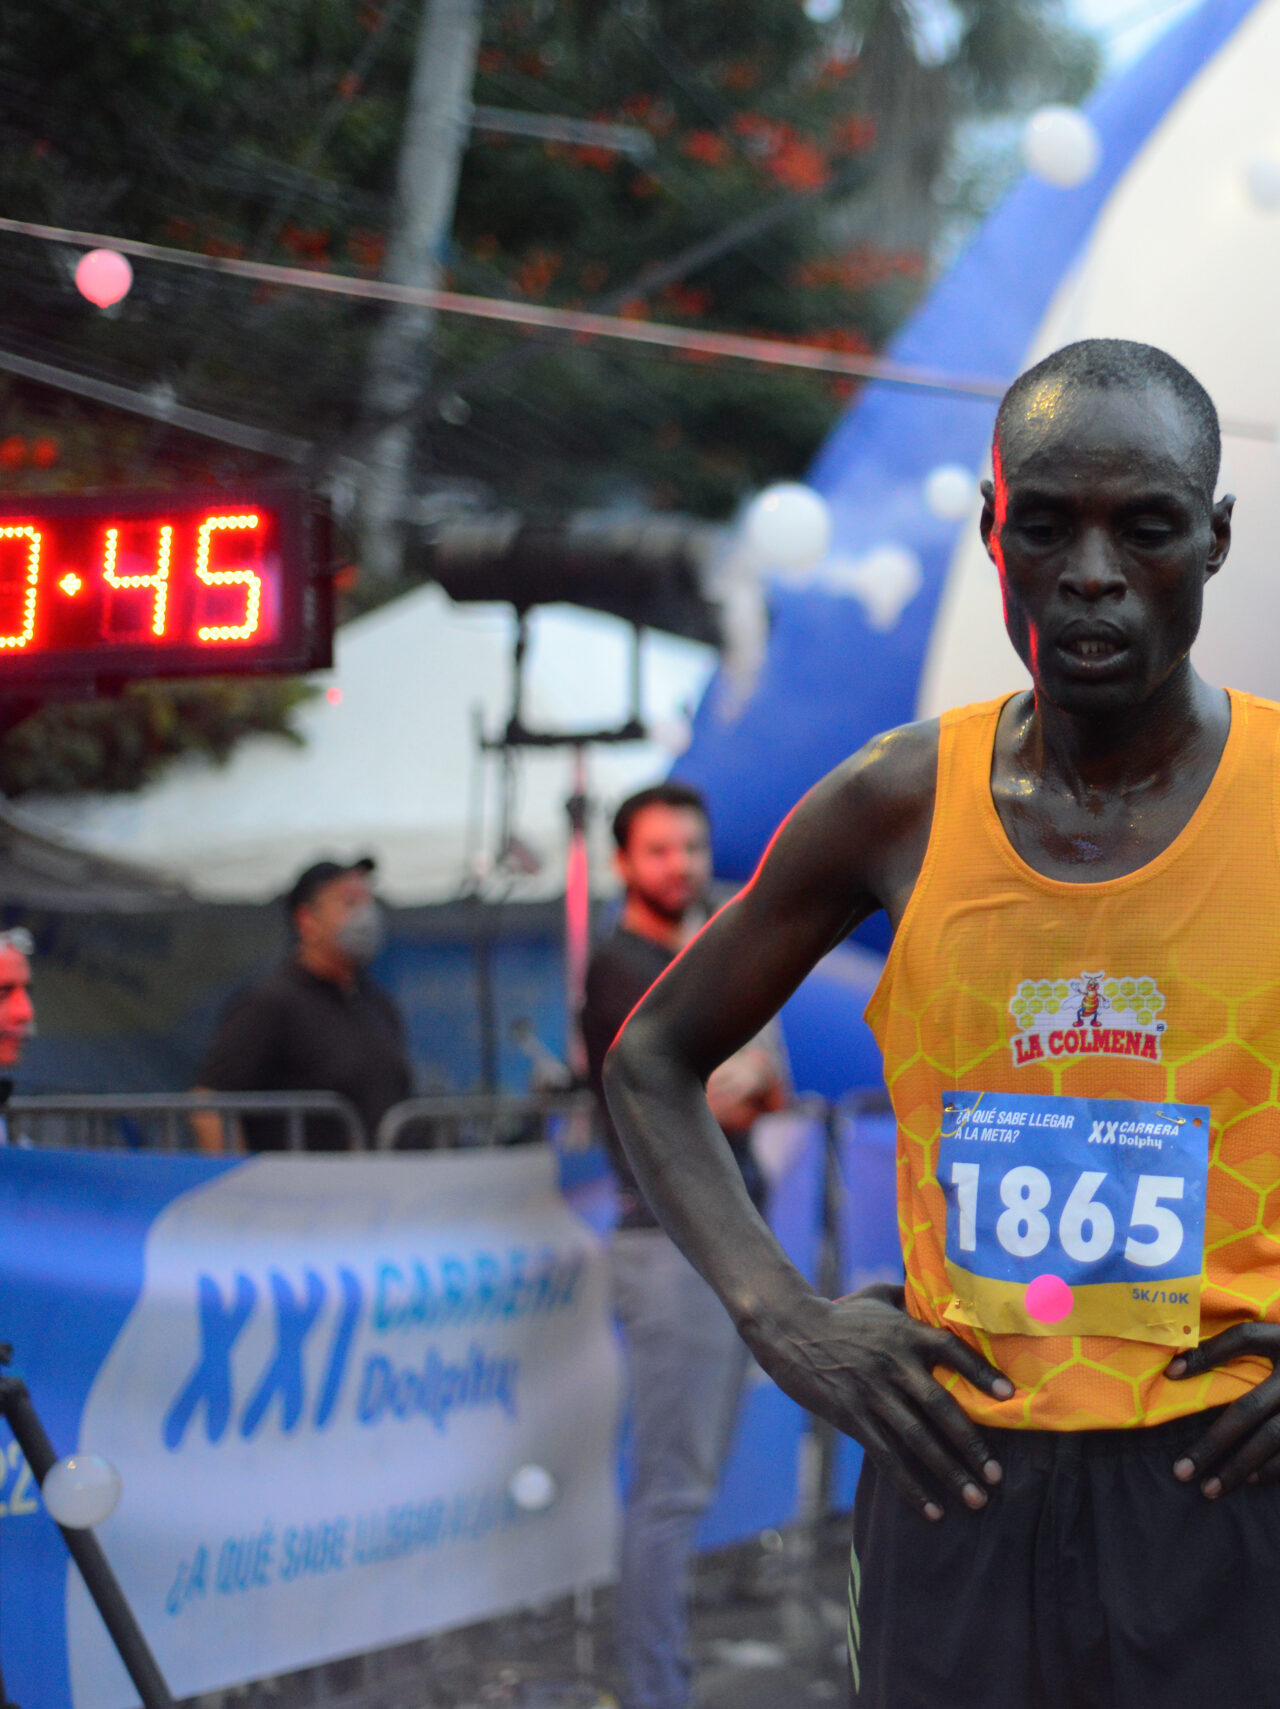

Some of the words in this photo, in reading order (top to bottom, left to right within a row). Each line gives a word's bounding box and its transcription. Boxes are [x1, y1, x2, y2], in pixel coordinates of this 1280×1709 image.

[1014, 1034, 1044, 1065] LA
[1048, 1028, 1157, 1060] COLMENA
[972, 1108, 996, 1124] QUÉ
[997, 1111, 1027, 1126] SABE
[1029, 1112, 1075, 1129] LLEGAR
[955, 1127, 964, 1139] A
[965, 1127, 979, 1140] LA
[981, 1129, 1020, 1143] META?
[1088, 1120, 1119, 1144] XX
[1120, 1122, 1180, 1136] CARRERA
[1119, 1134, 1162, 1149] Dolphy
[951, 1162, 1184, 1267] 1865
[1132, 1288, 1190, 1304] 5K/10K
[161, 1262, 364, 1453] XXI
[216, 1517, 274, 1594] QUÉ
